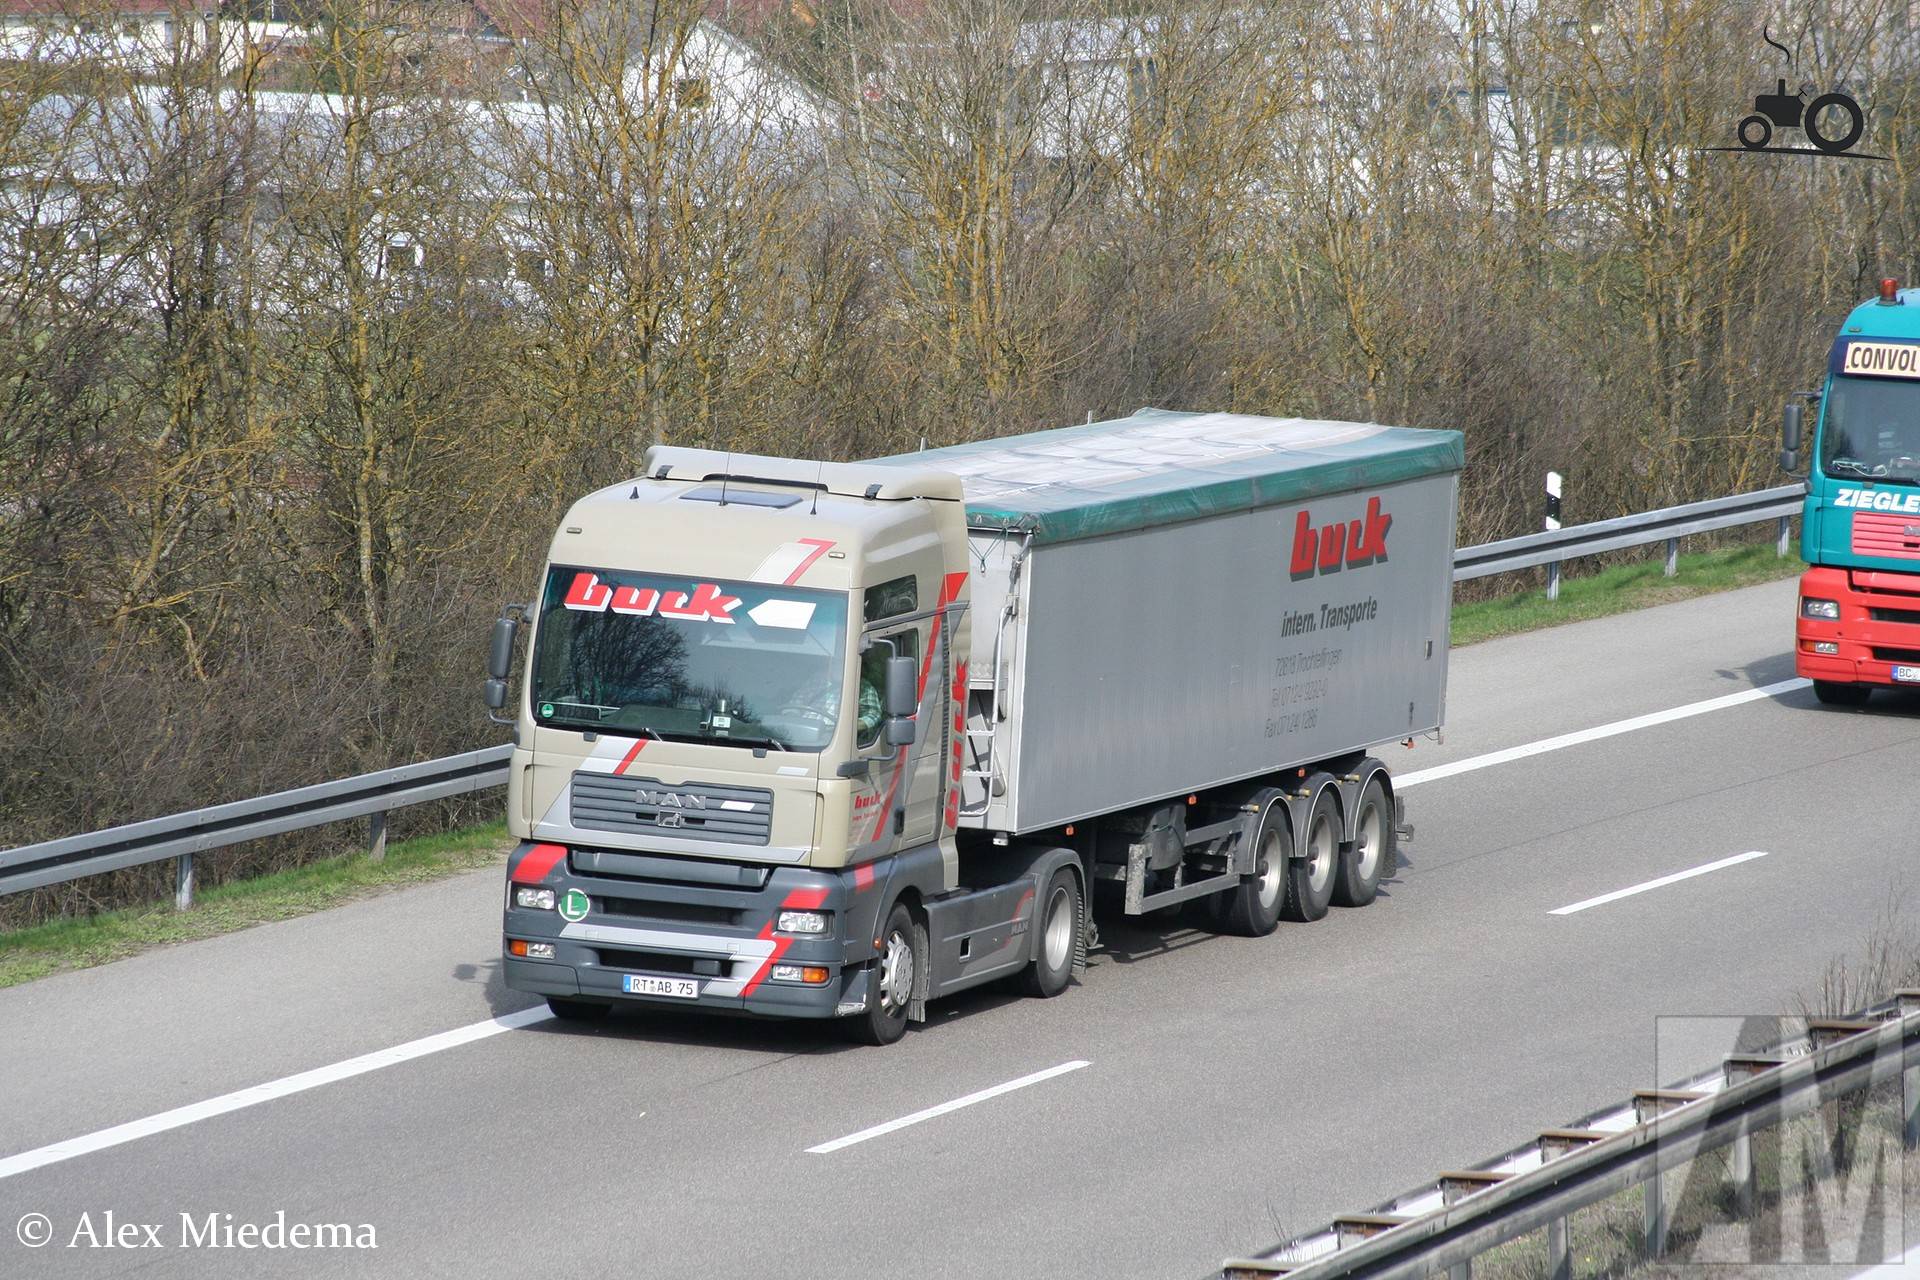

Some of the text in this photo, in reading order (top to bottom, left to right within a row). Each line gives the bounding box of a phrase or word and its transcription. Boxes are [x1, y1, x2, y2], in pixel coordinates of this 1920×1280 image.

[1833, 488, 1920, 513] ZIEGLE
[1290, 496, 1393, 582] buck
[564, 572, 743, 624] buck
[1281, 596, 1378, 638] intern. Transporte
[635, 789, 707, 811] MAN
[567, 894, 581, 916] L
